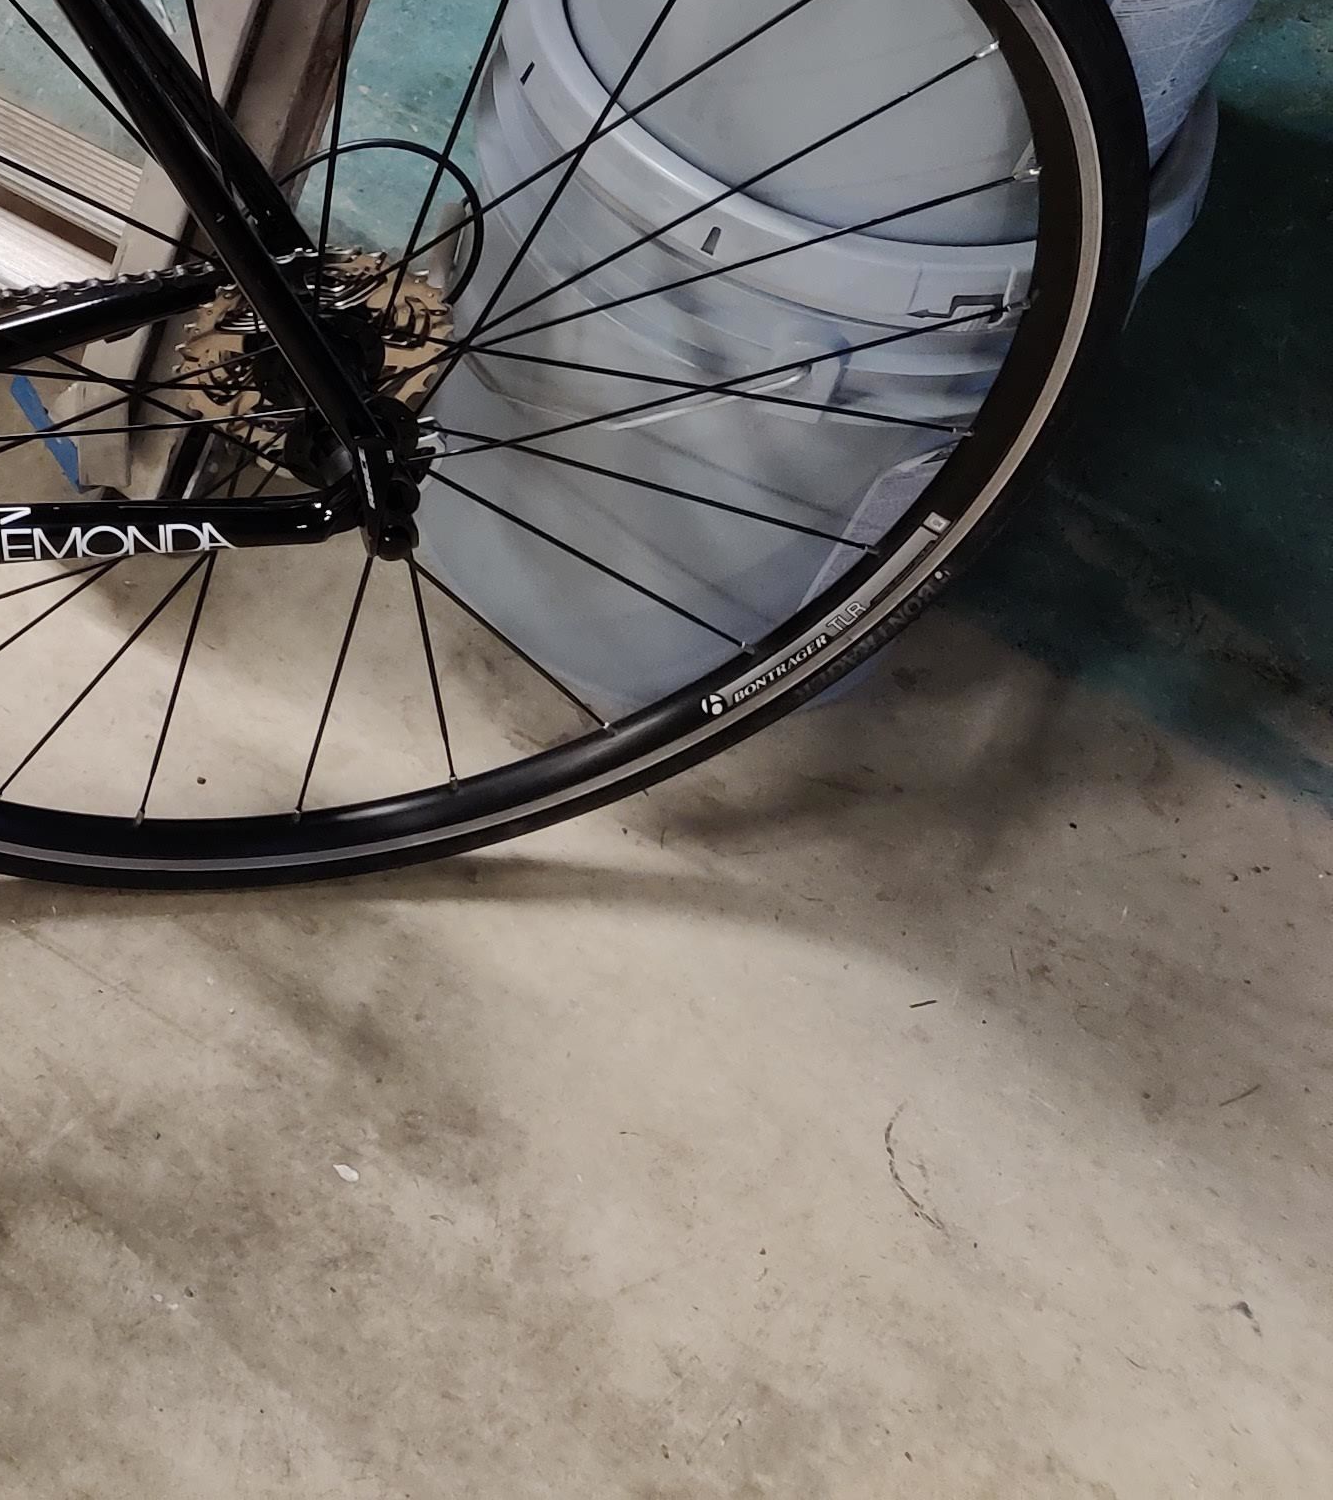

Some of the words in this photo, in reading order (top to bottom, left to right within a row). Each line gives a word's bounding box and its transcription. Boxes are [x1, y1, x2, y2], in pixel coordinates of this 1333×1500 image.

[0, 507, 238, 562] ÉMONDA
[734, 633, 828, 703] BONTRAGER
[825, 601, 867, 633] TLR
